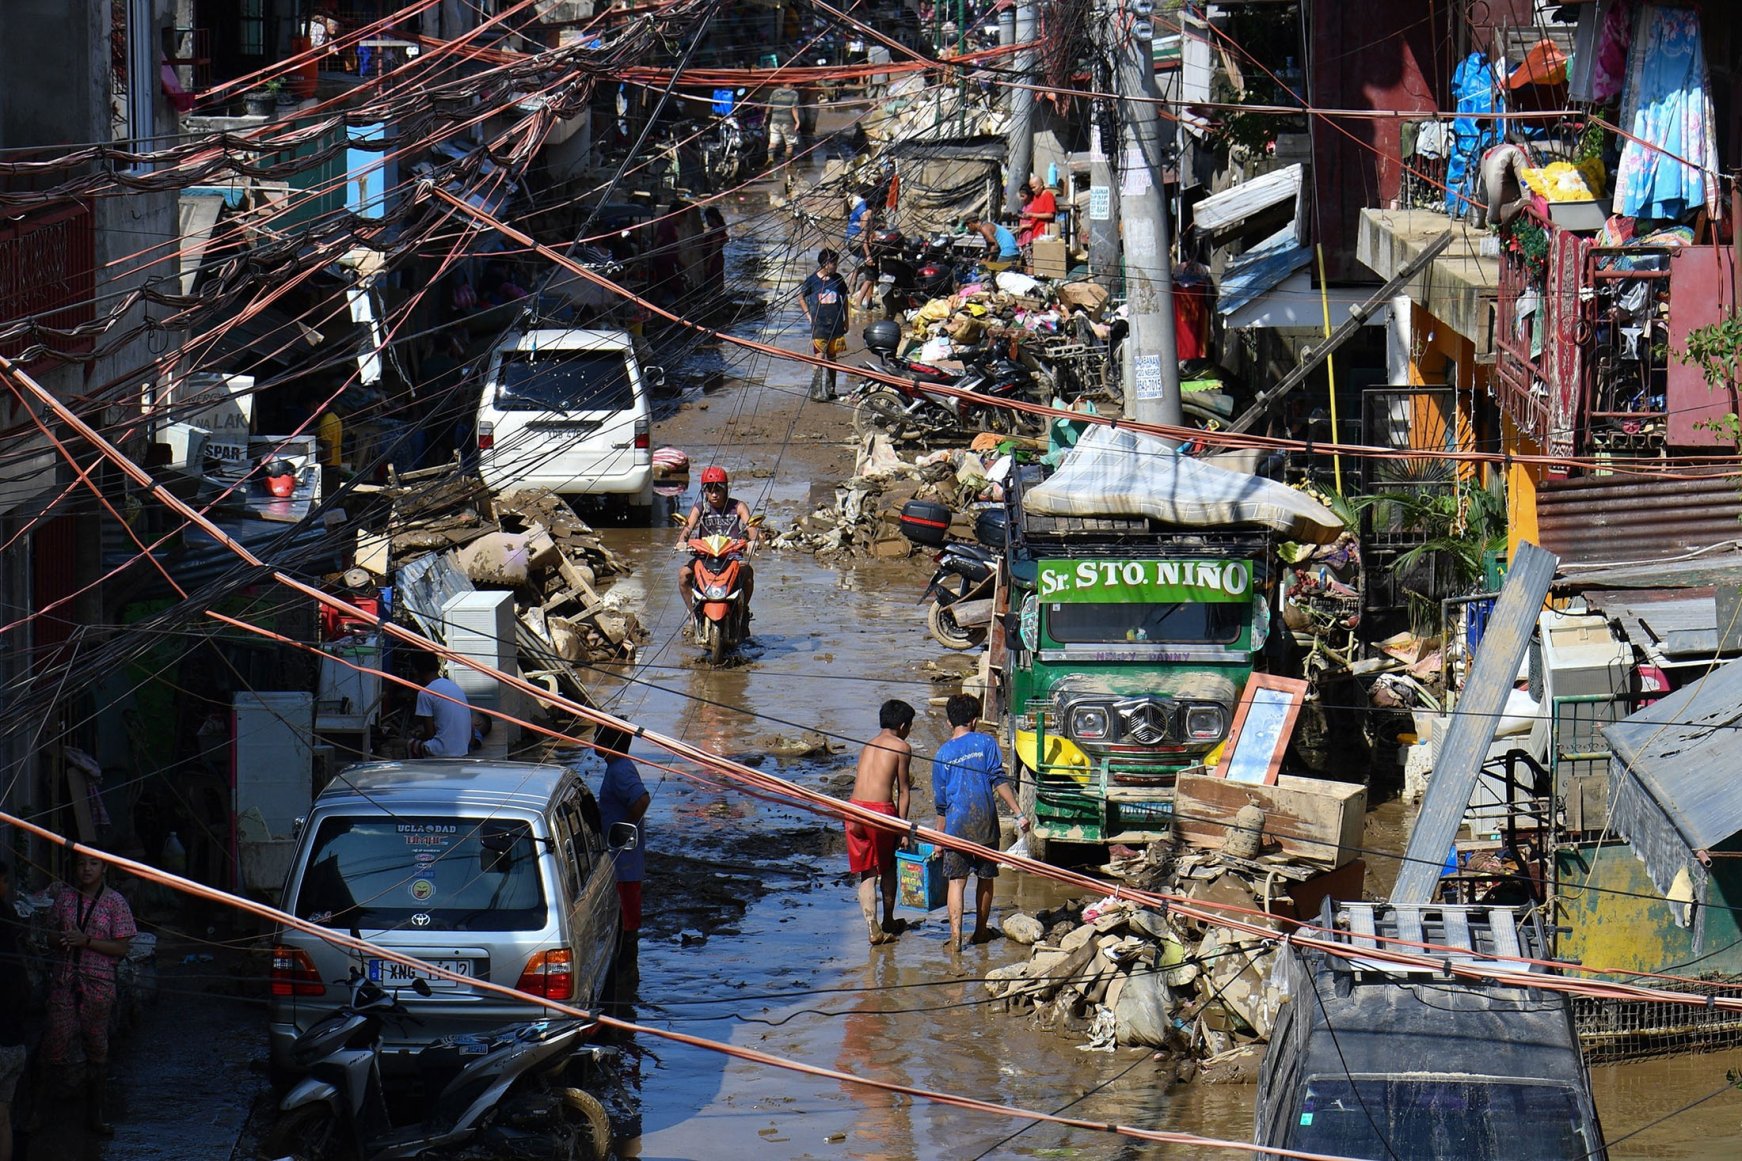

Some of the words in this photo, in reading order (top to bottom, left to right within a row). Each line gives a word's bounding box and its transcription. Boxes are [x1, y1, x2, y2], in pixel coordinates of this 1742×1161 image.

[705, 518, 732, 527] GUESS
[1041, 569, 1070, 595] Sr.
[1076, 562, 1149, 588] STO.
[1156, 562, 1248, 595] NIÑO
[435, 825, 457, 833] DAD
[390, 964, 416, 979] XNG
